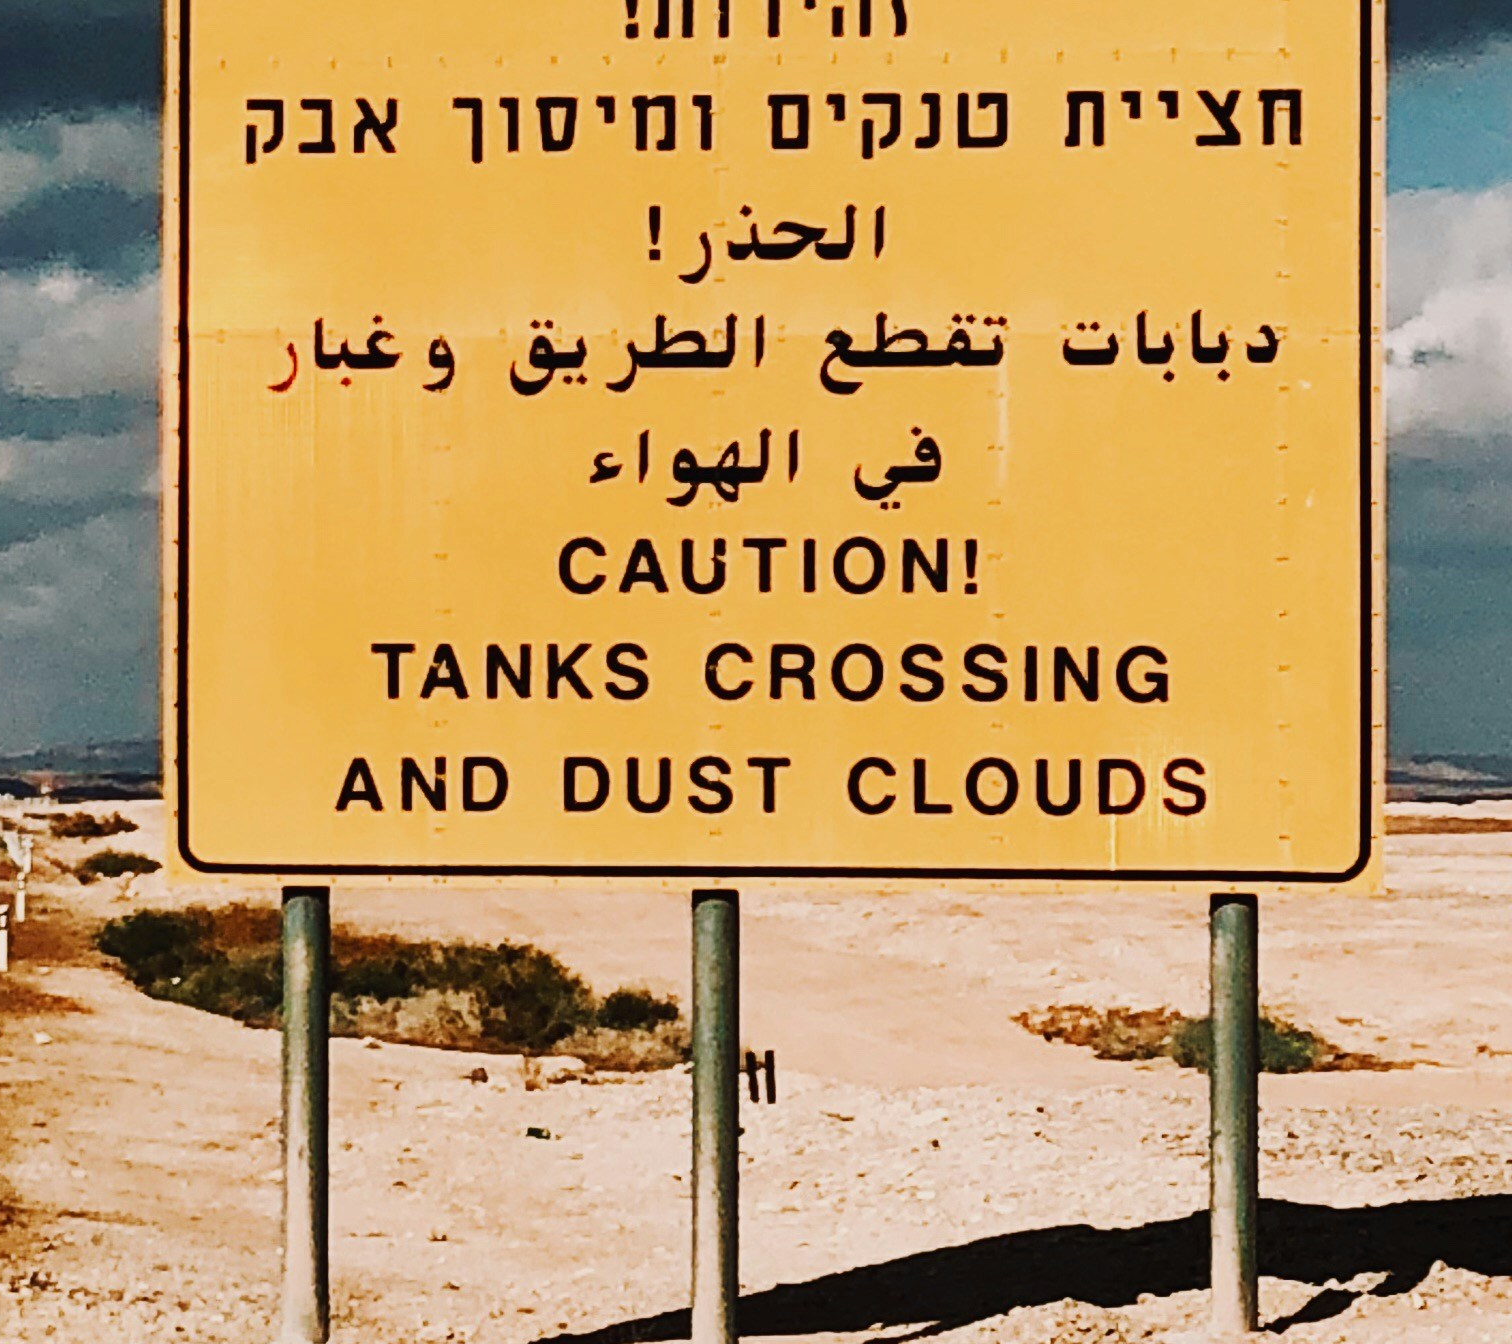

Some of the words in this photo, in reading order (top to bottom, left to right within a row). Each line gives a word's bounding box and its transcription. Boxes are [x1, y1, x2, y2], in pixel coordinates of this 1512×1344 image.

[245, 97, 398, 165] אבק
[452, 94, 714, 165] ומיסוך
[767, 92, 1009, 160] טנקים
[1064, 88, 1303, 148] חציית
[648, 203, 886, 285] الحذر!
[509, 312, 765, 397] الطريق
[819, 311, 1008, 396] تقطع
[1062, 309, 1281, 383] دبابات
[589, 427, 799, 508] الهواء
[853, 426, 943, 511] في
[558, 535, 978, 595] CAUTION!
[370, 642, 650, 701] TANKS
[704, 642, 1169, 704] CROSSING
[334, 755, 509, 813] AND
[563, 755, 792, 815] DUST
[846, 756, 1207, 817] CLOUDS
